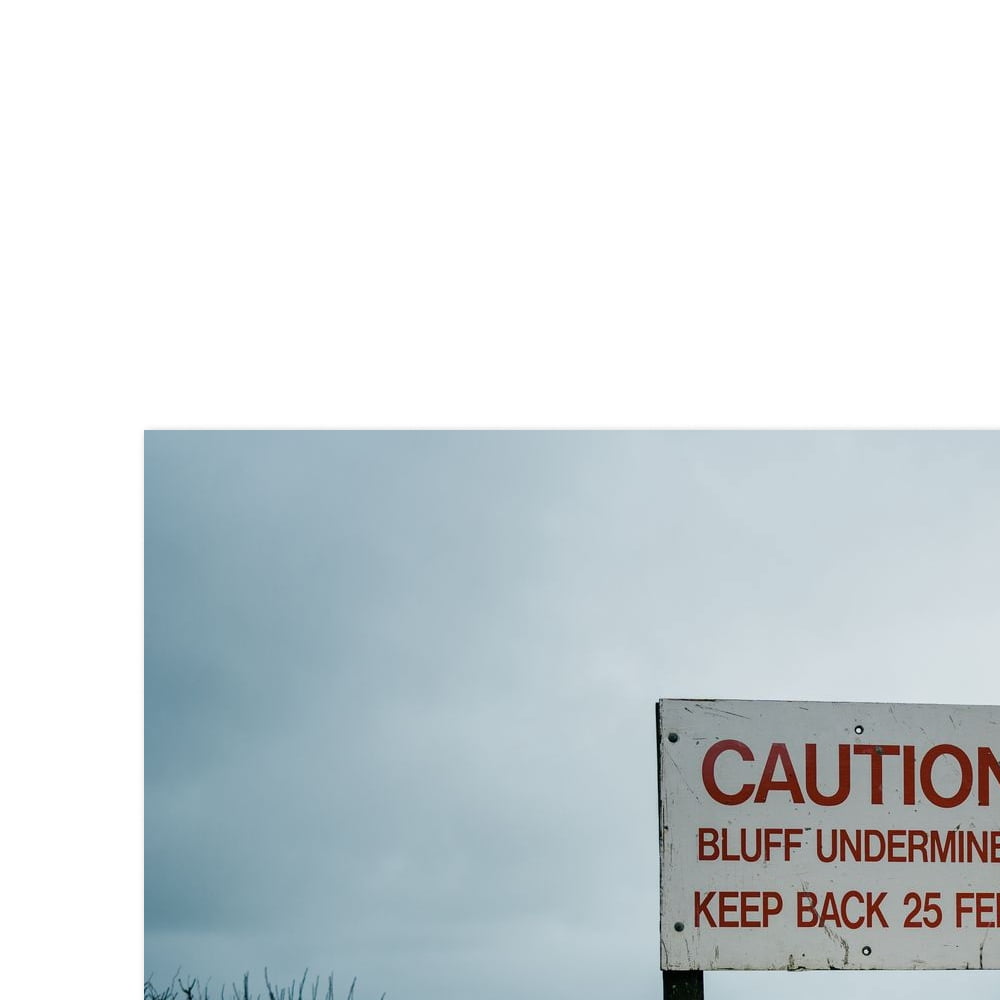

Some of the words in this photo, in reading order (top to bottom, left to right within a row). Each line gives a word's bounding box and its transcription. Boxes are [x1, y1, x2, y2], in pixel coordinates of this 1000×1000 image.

[698, 828, 803, 862] BLUFF
[694, 891, 783, 928] KEEP
[796, 890, 889, 929] BACK
[903, 892, 943, 928] 25
